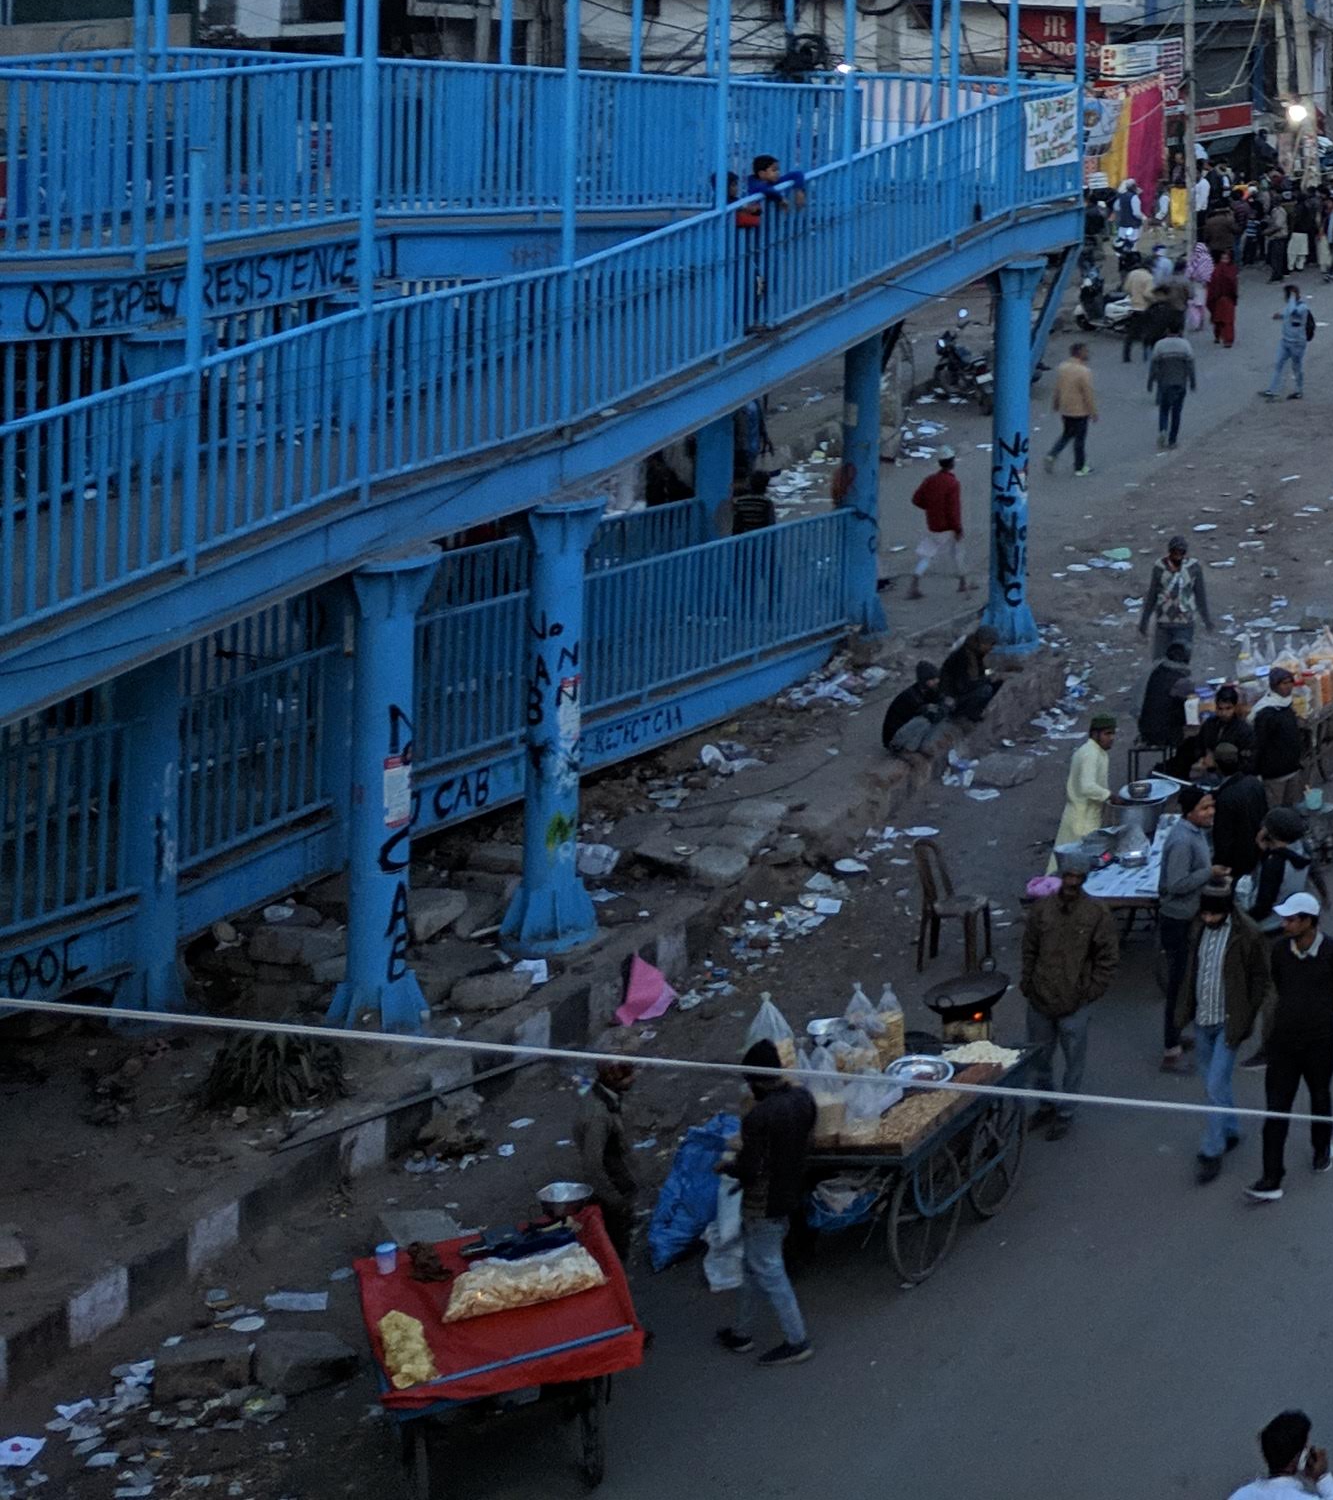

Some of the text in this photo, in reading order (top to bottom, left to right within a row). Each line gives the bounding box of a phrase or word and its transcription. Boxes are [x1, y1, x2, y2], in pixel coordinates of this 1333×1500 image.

[24, 281, 80, 333] OR
[89, 275, 186, 329] EXPECT
[202, 247, 359, 309] RESISTENCE
[432, 766, 491, 820] CAB
